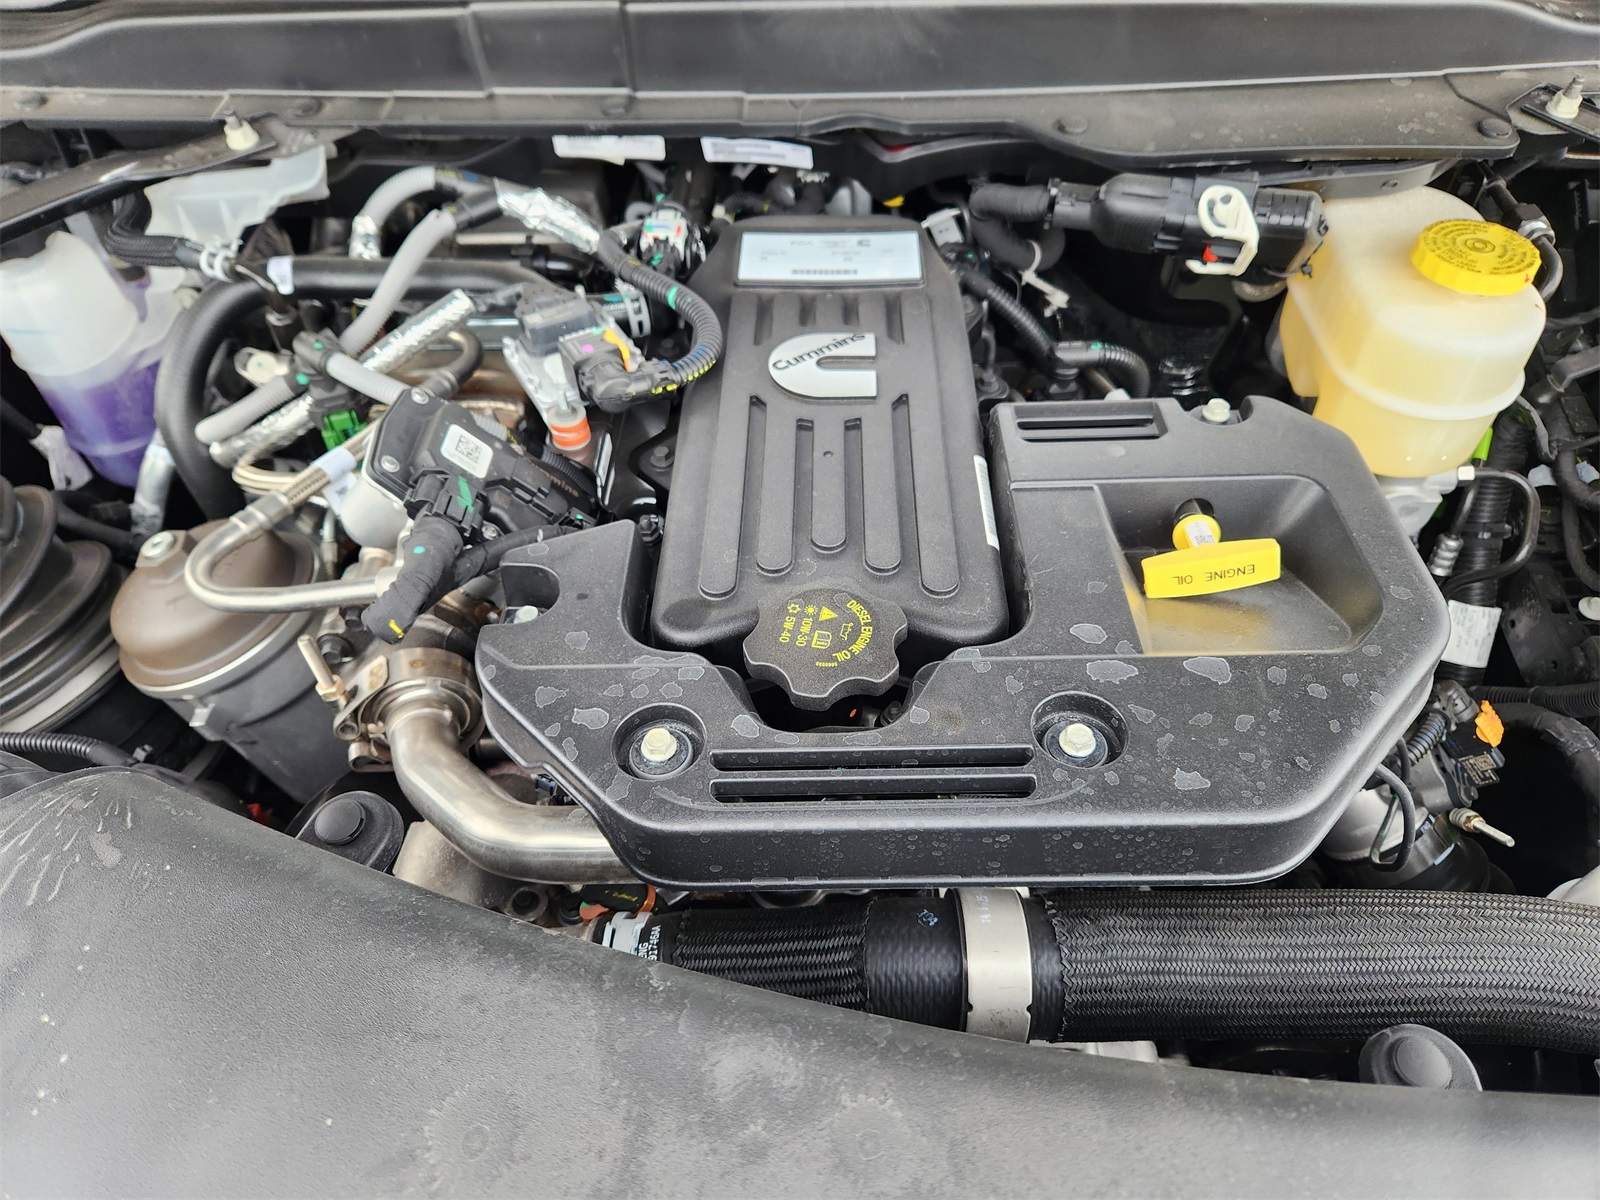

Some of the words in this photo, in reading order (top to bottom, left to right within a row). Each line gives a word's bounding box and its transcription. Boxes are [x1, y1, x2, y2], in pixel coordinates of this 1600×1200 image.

[772, 333, 866, 371] Cummins
[1172, 575, 1193, 586] OIL
[1204, 563, 1256, 582] ENGINE
[846, 599, 872, 626] DIESEL
[779, 616, 796, 643] 5W-40
[795, 617, 814, 647] 10W-30
[848, 626, 873, 656] ENGINE
[832, 650, 851, 663] OIL
